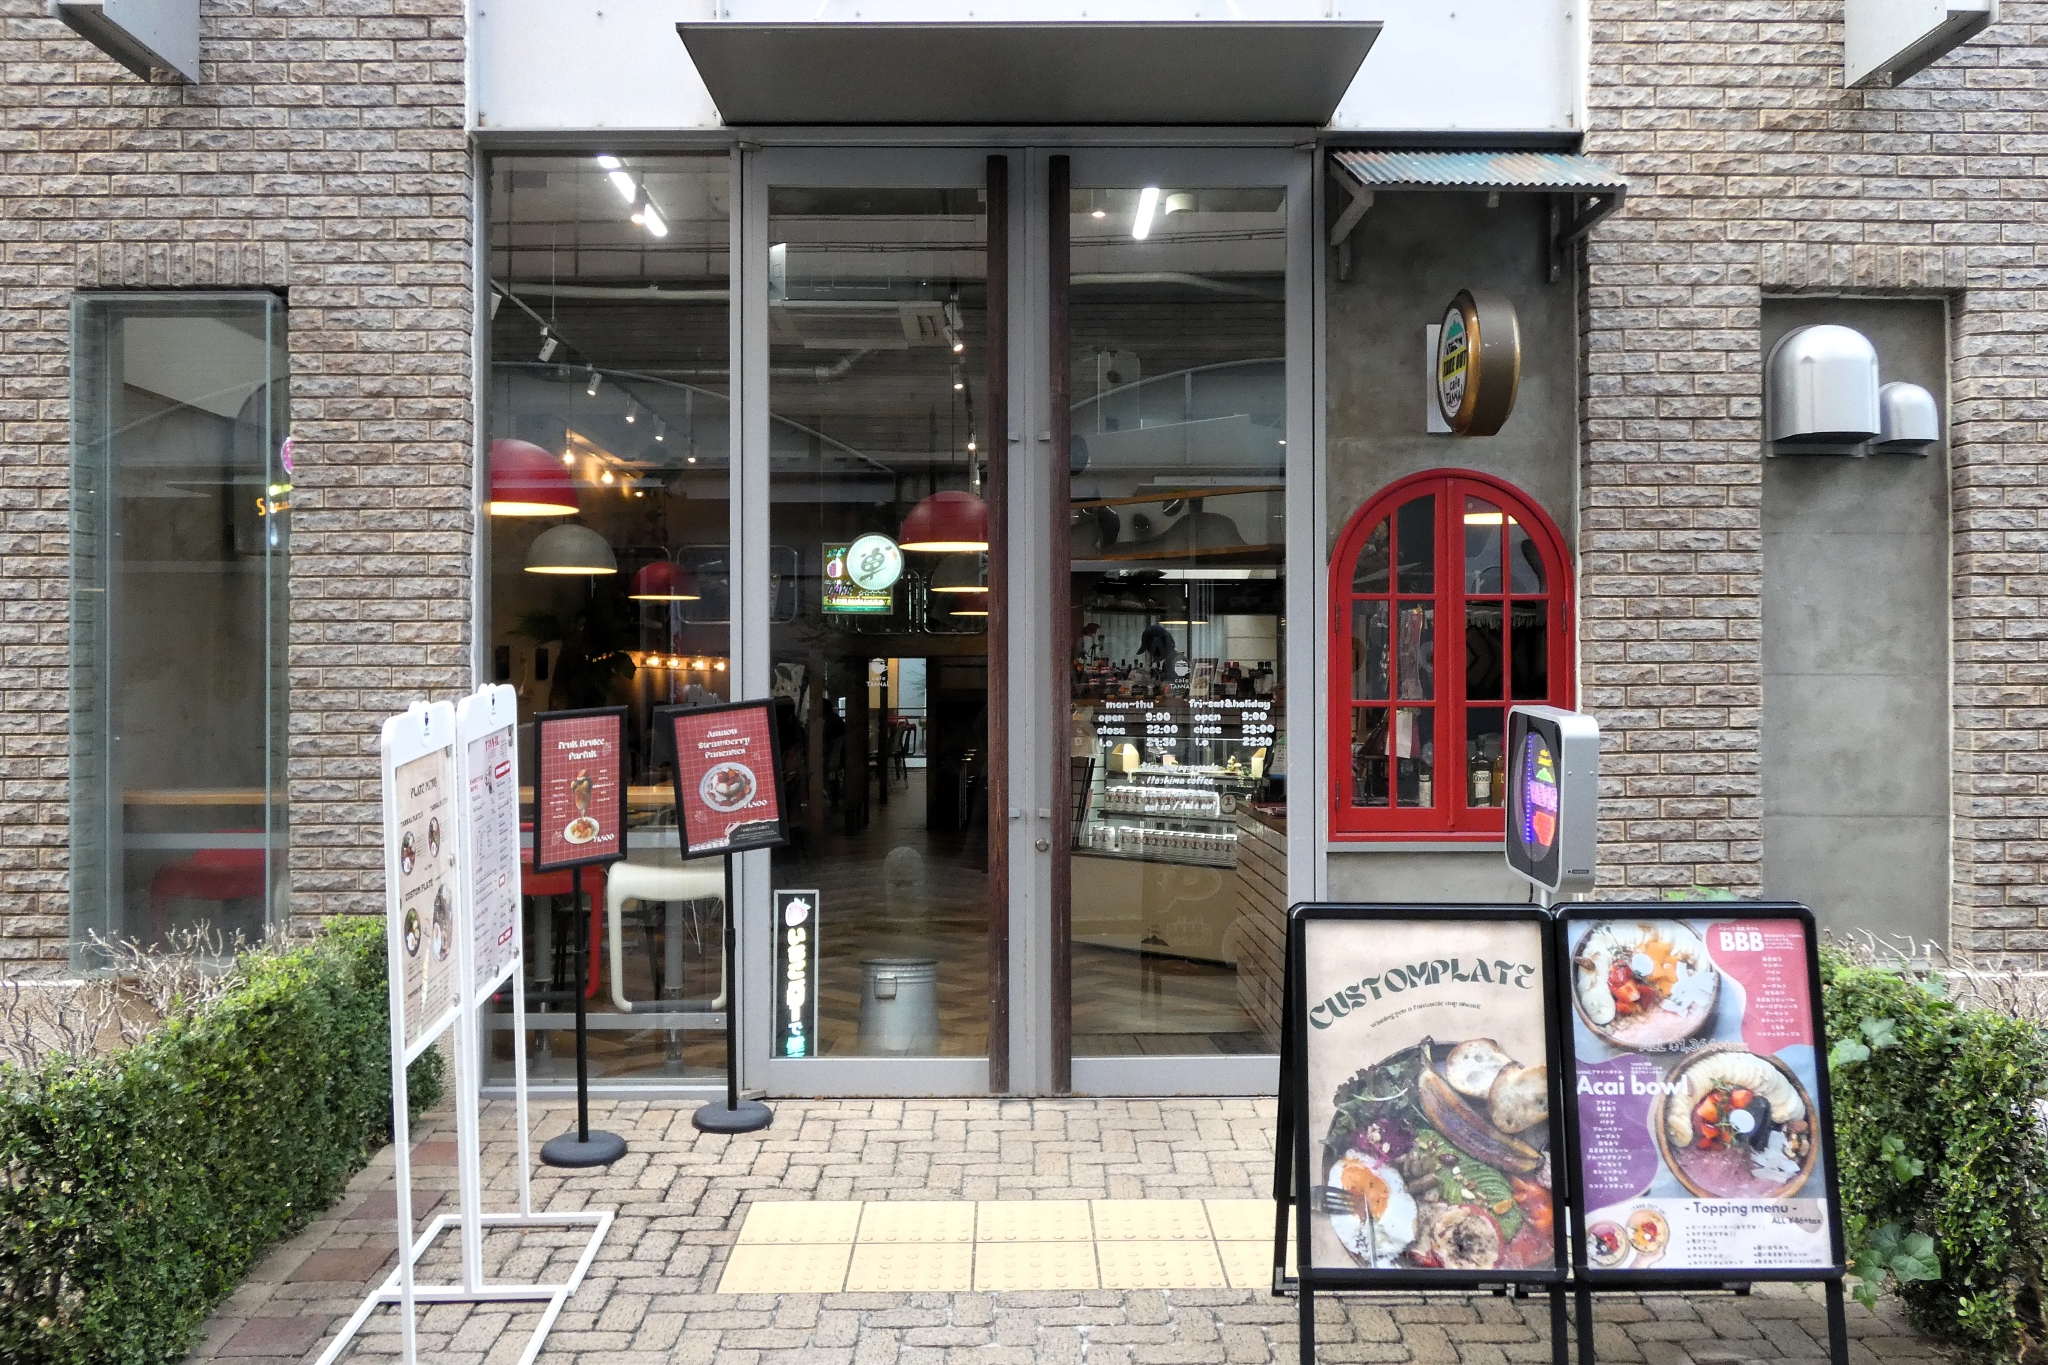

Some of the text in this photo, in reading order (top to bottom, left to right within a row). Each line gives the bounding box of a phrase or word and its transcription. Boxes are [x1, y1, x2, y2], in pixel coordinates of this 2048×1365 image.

[1098, 712, 1170, 724] open 9:00
[1194, 711, 1267, 724] open 9:00
[1097, 725, 1178, 735] close 22:00
[1194, 724, 1275, 735] close 23:00
[698, 737, 750, 749] Strawberry
[1242, 737, 1272, 746] 22:30
[705, 748, 746, 759] Pancakes
[1187, 776, 1214, 785] coffee
[1145, 803, 1158, 811] eat
[1181, 801, 1199, 810] take
[1201, 802, 1217, 810] out
[1720, 932, 1764, 951] BBB
[1577, 1075, 1687, 1095] Acai bowl
[1693, 1202, 1788, 1216] Topping menu
